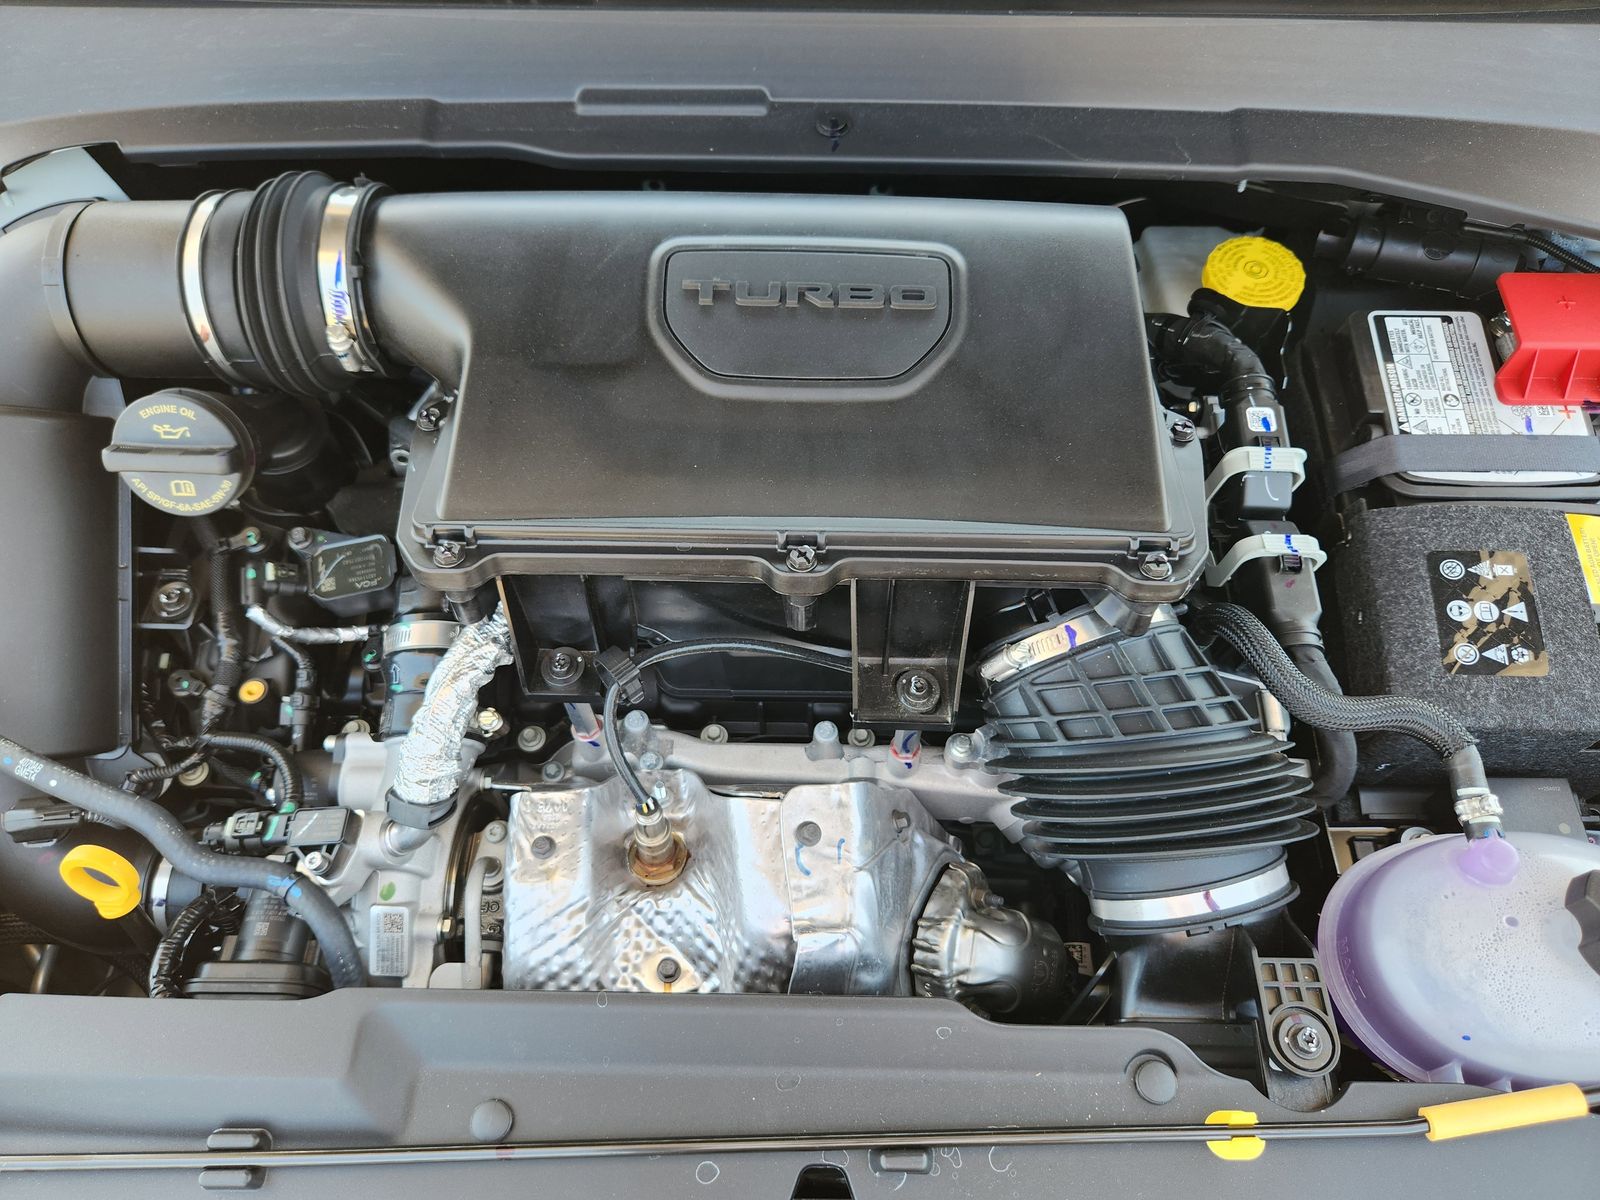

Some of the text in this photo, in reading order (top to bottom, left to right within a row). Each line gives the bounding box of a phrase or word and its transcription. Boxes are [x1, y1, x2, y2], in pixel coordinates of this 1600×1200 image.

[682, 278, 937, 311] TURBO
[1385, 363, 1407, 421] DANGER/POISON
[138, 404, 197, 420] ENGINE OIL
[131, 478, 147, 493] API
